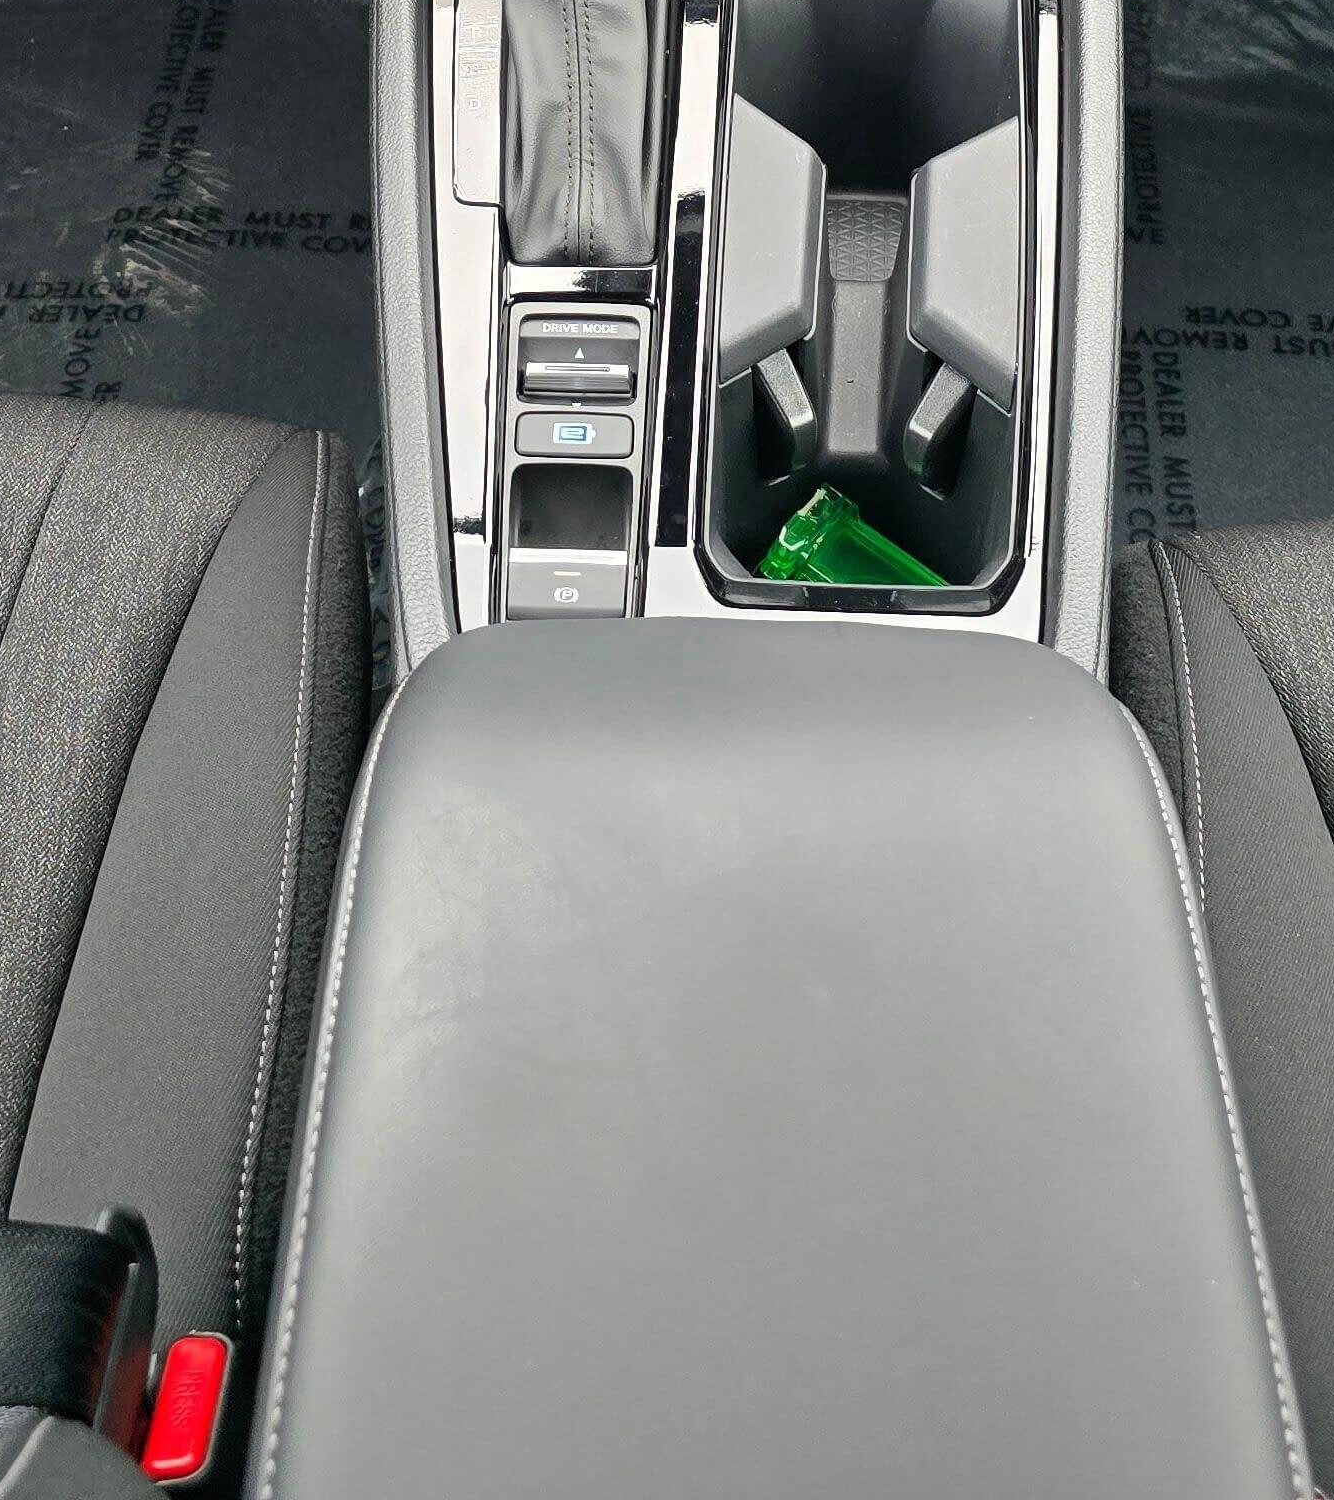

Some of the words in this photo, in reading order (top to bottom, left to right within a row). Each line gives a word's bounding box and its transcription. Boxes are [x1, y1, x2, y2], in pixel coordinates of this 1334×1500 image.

[111, 204, 226, 226] DEALER
[245, 210, 332, 229] MUST
[28, 302, 147, 325] DEALER
[1183, 305, 1292, 330] COVER
[542, 322, 579, 333] DRIVE
[582, 322, 618, 334] MODE
[1153, 350, 1188, 438] DEALER
[1162, 455, 1198, 532] MUST
[170, 1369, 204, 1429] PRESS
